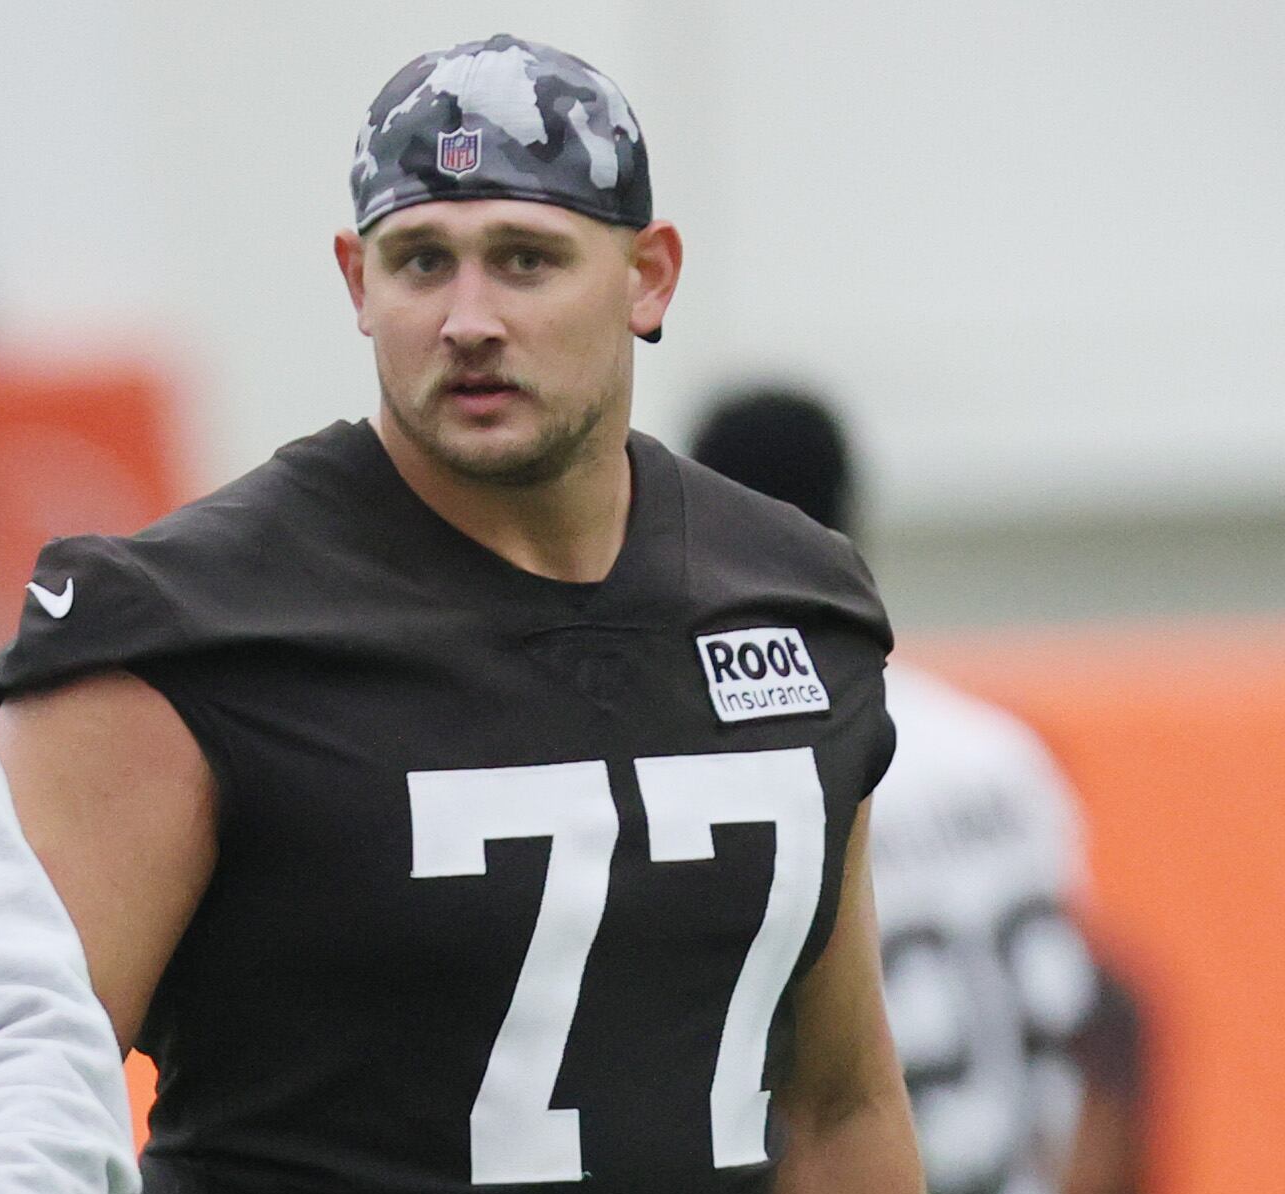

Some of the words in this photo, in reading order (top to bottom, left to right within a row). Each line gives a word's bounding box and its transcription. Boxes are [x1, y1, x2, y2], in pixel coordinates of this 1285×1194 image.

[706, 636, 809, 684] Root
[717, 683, 823, 713] Insurance
[406, 746, 827, 1185] 77
